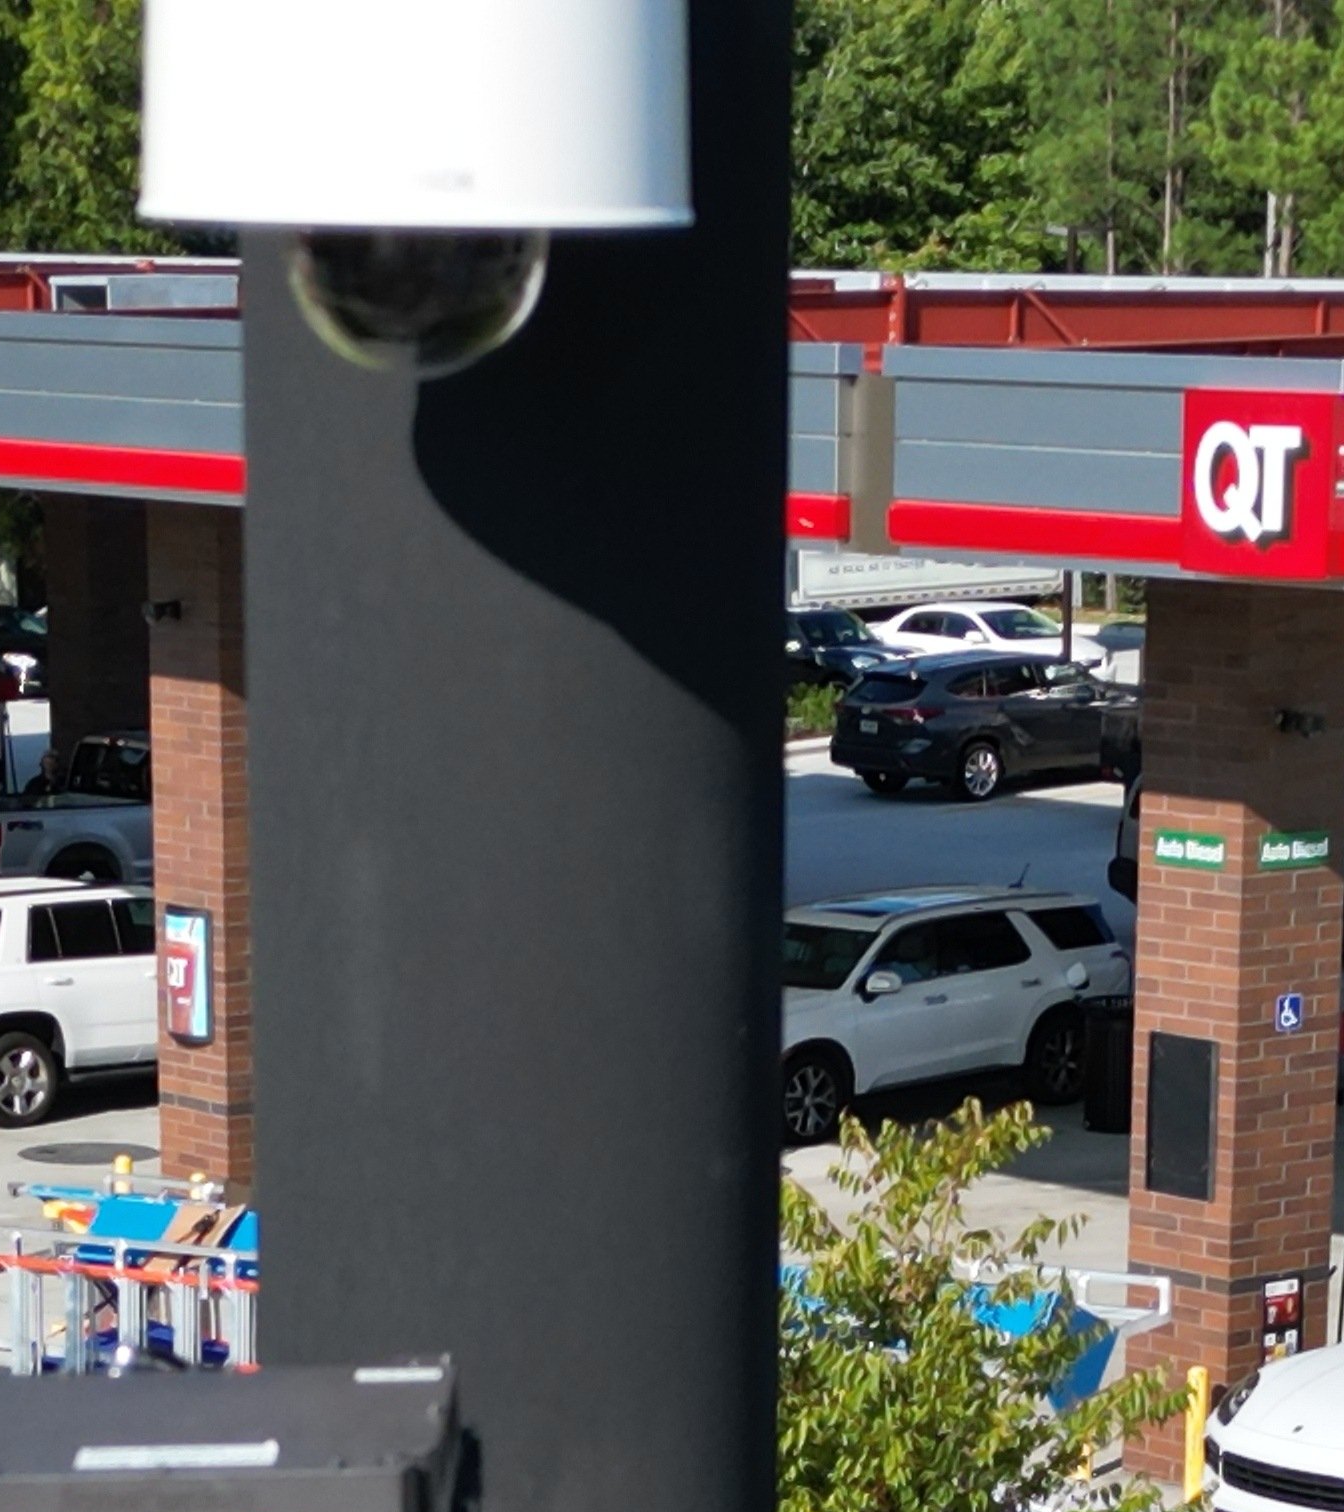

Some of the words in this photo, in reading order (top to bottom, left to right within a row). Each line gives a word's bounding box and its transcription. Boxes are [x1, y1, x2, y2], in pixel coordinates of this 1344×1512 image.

[1194, 421, 1302, 542] QT
[1156, 837, 1184, 858] Auto
[1261, 842, 1290, 862] Auto
